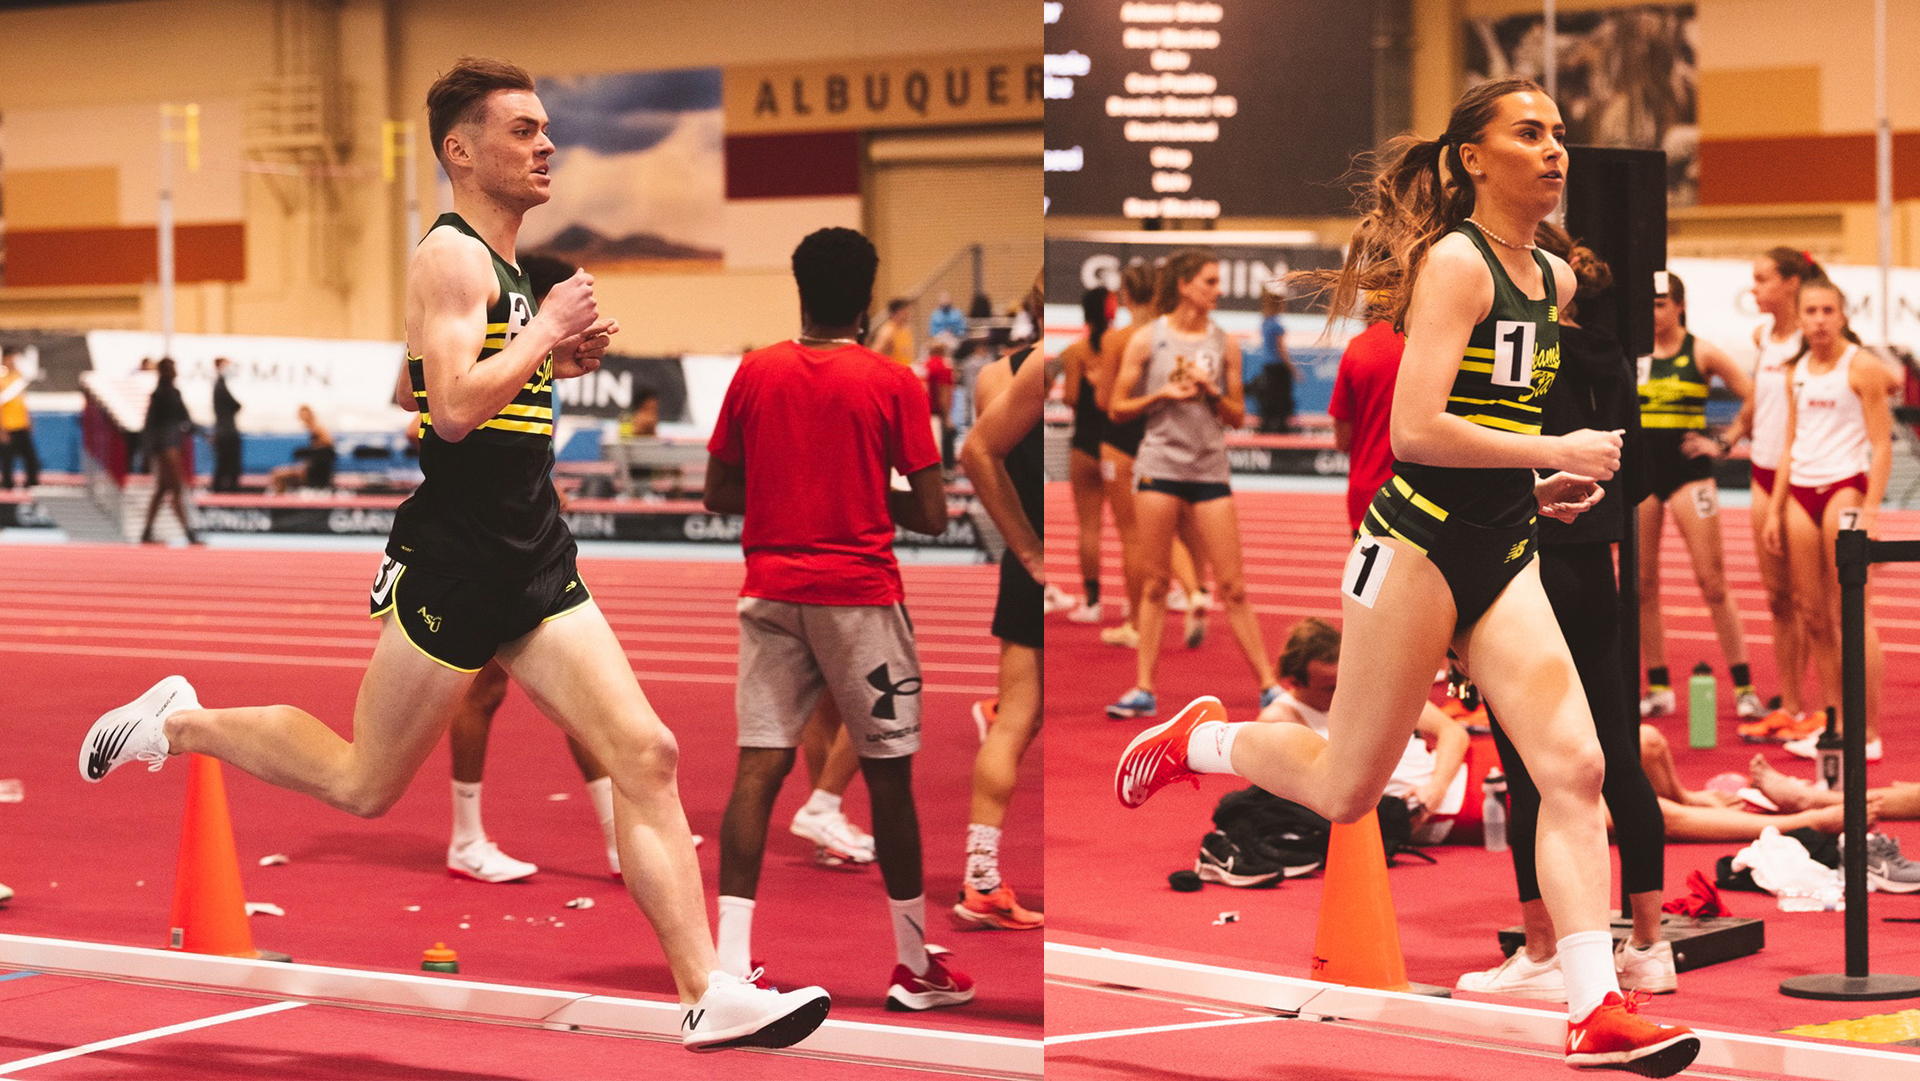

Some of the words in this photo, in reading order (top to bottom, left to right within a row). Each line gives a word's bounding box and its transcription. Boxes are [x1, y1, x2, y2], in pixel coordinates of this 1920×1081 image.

[1503, 326, 1525, 382] 1
[1352, 543, 1381, 597] 1
[416, 605, 442, 633] ASU
